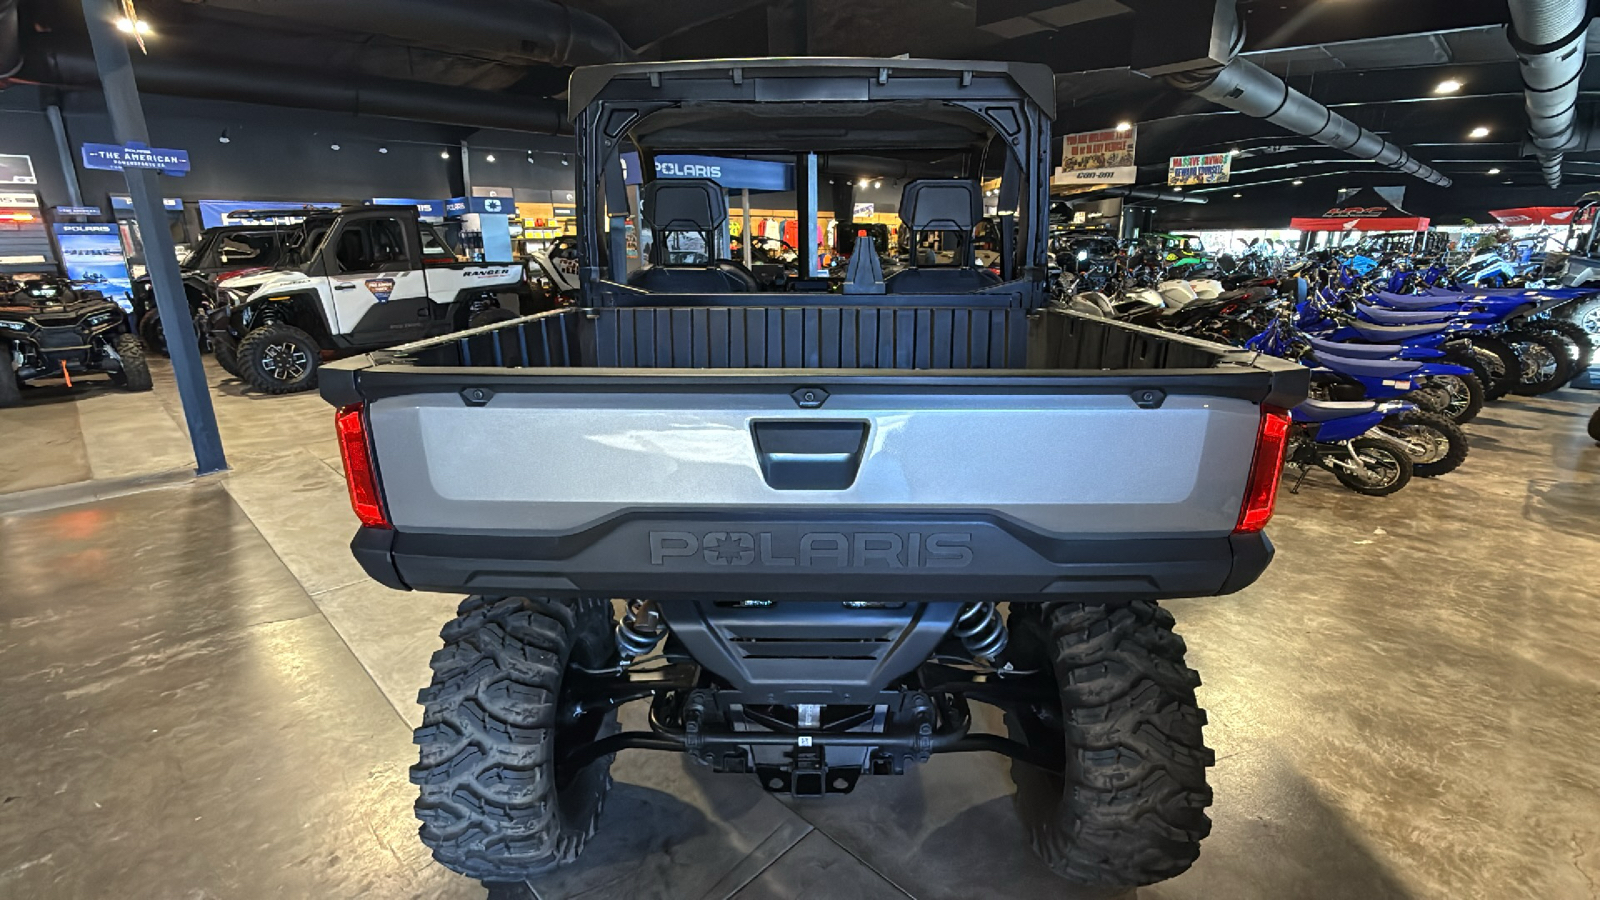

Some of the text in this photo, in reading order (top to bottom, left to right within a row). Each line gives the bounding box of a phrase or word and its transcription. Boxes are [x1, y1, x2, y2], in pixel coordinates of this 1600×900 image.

[98, 151, 178, 163] THE AMERICAN
[655, 161, 722, 177] POLARIS
[462, 269, 510, 277] RANGER
[648, 530, 975, 569] POLARIS
